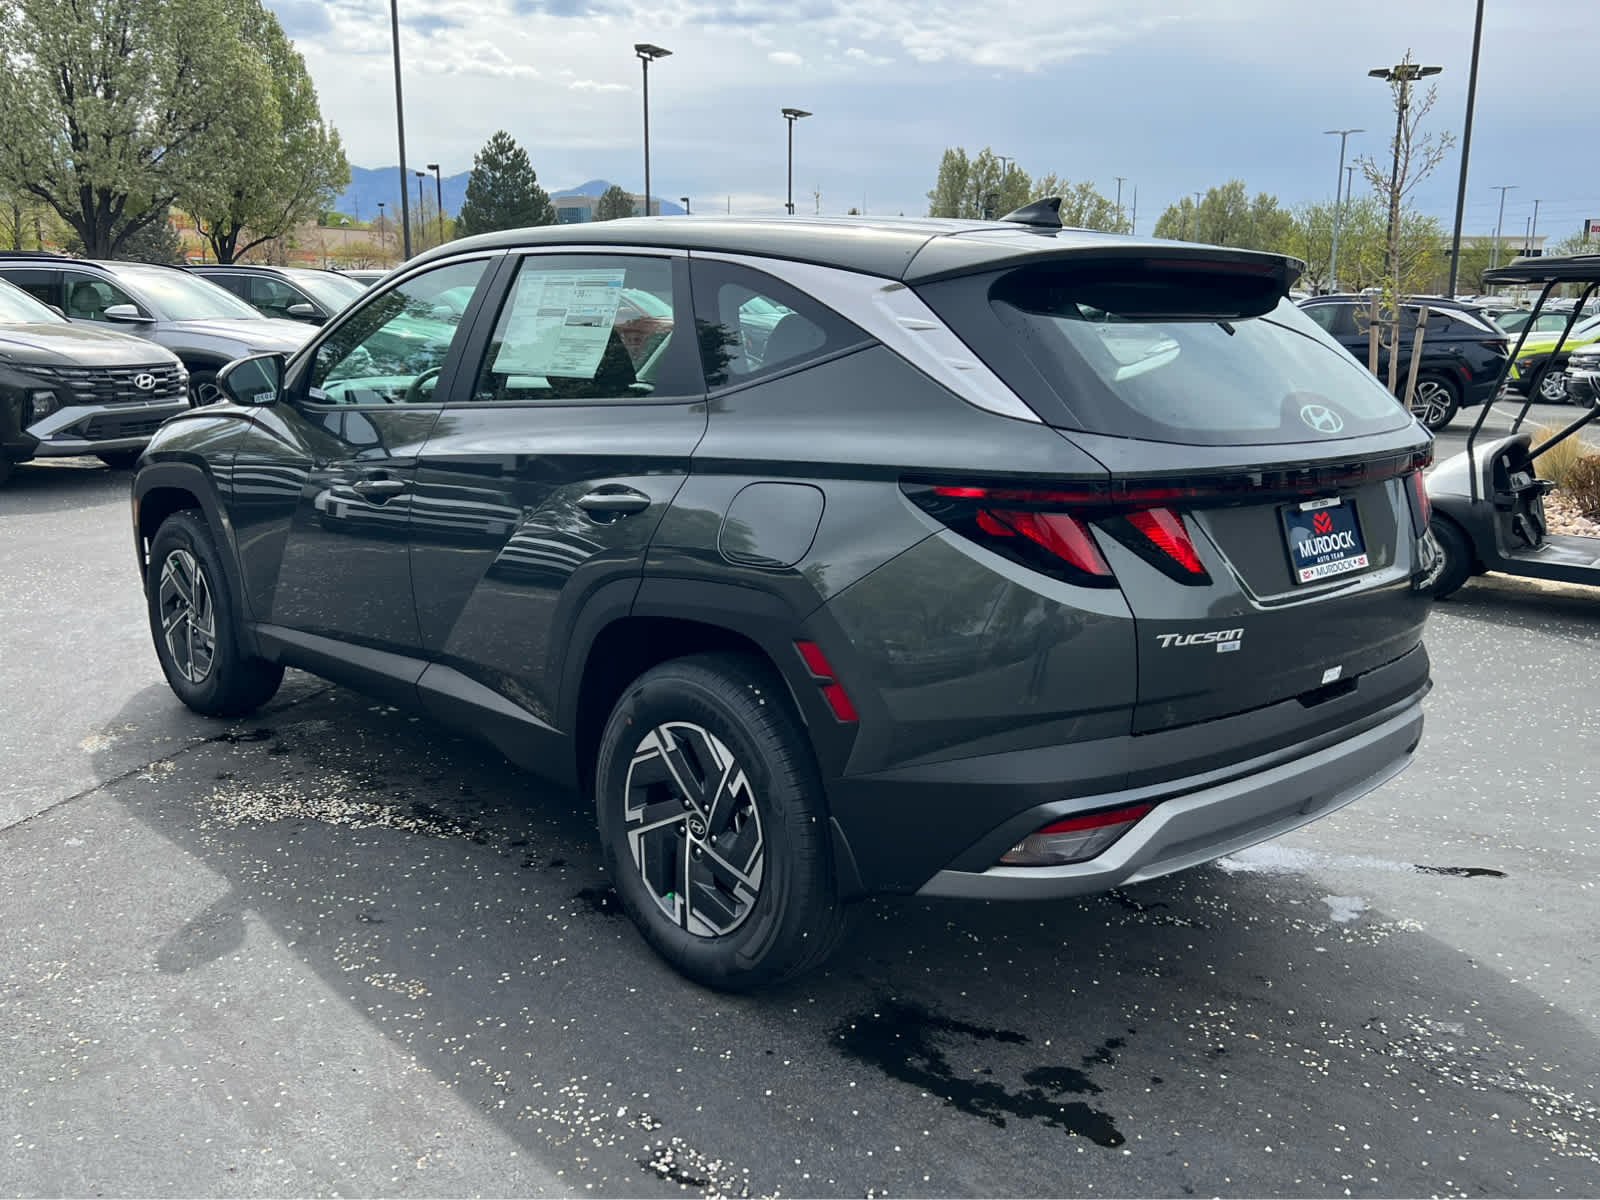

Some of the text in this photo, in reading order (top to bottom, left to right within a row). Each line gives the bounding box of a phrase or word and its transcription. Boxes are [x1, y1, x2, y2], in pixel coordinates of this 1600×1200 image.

[1298, 530, 1355, 558] MURDOCK
[1317, 555, 1330, 563] AUTO
[1316, 560, 1353, 576] MURDOCK
